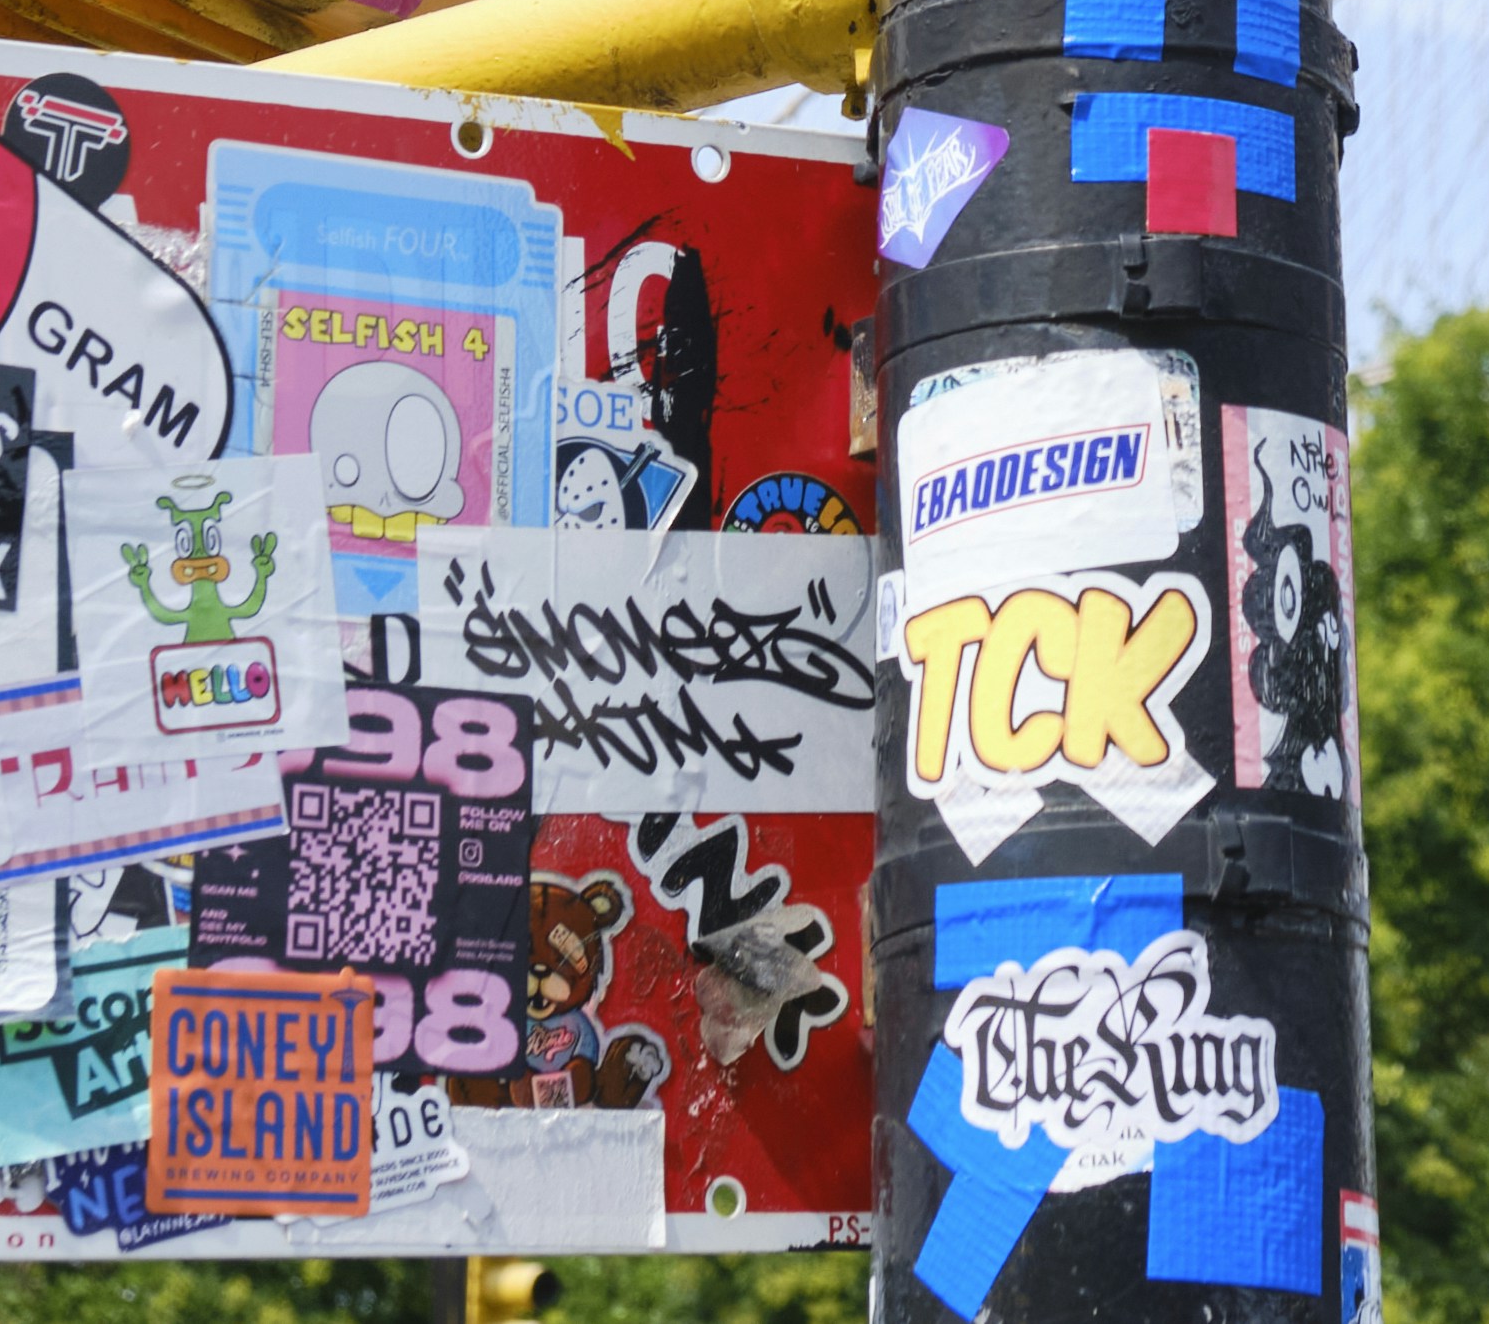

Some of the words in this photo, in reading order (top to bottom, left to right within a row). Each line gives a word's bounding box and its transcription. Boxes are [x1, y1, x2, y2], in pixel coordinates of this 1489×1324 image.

[282, 306, 445, 357] SELFISH
[463, 329, 489, 361] 4
[28, 300, 200, 448] GRAM
[905, 588, 1198, 782] TCK
[279, 689, 525, 799] 98
[460, 817, 486, 831] ME
[489, 820, 512, 833] ON
[461, 806, 527, 823] FOLLOW
[200, 884, 235, 897] SCAN
[236, 885, 259, 898] ME
[167, 1008, 337, 1081] CONEY
[167, 1088, 360, 1161] ISLAND
[166, 1168, 256, 1183] BREWING
[265, 1171, 360, 1184] COMPANY
